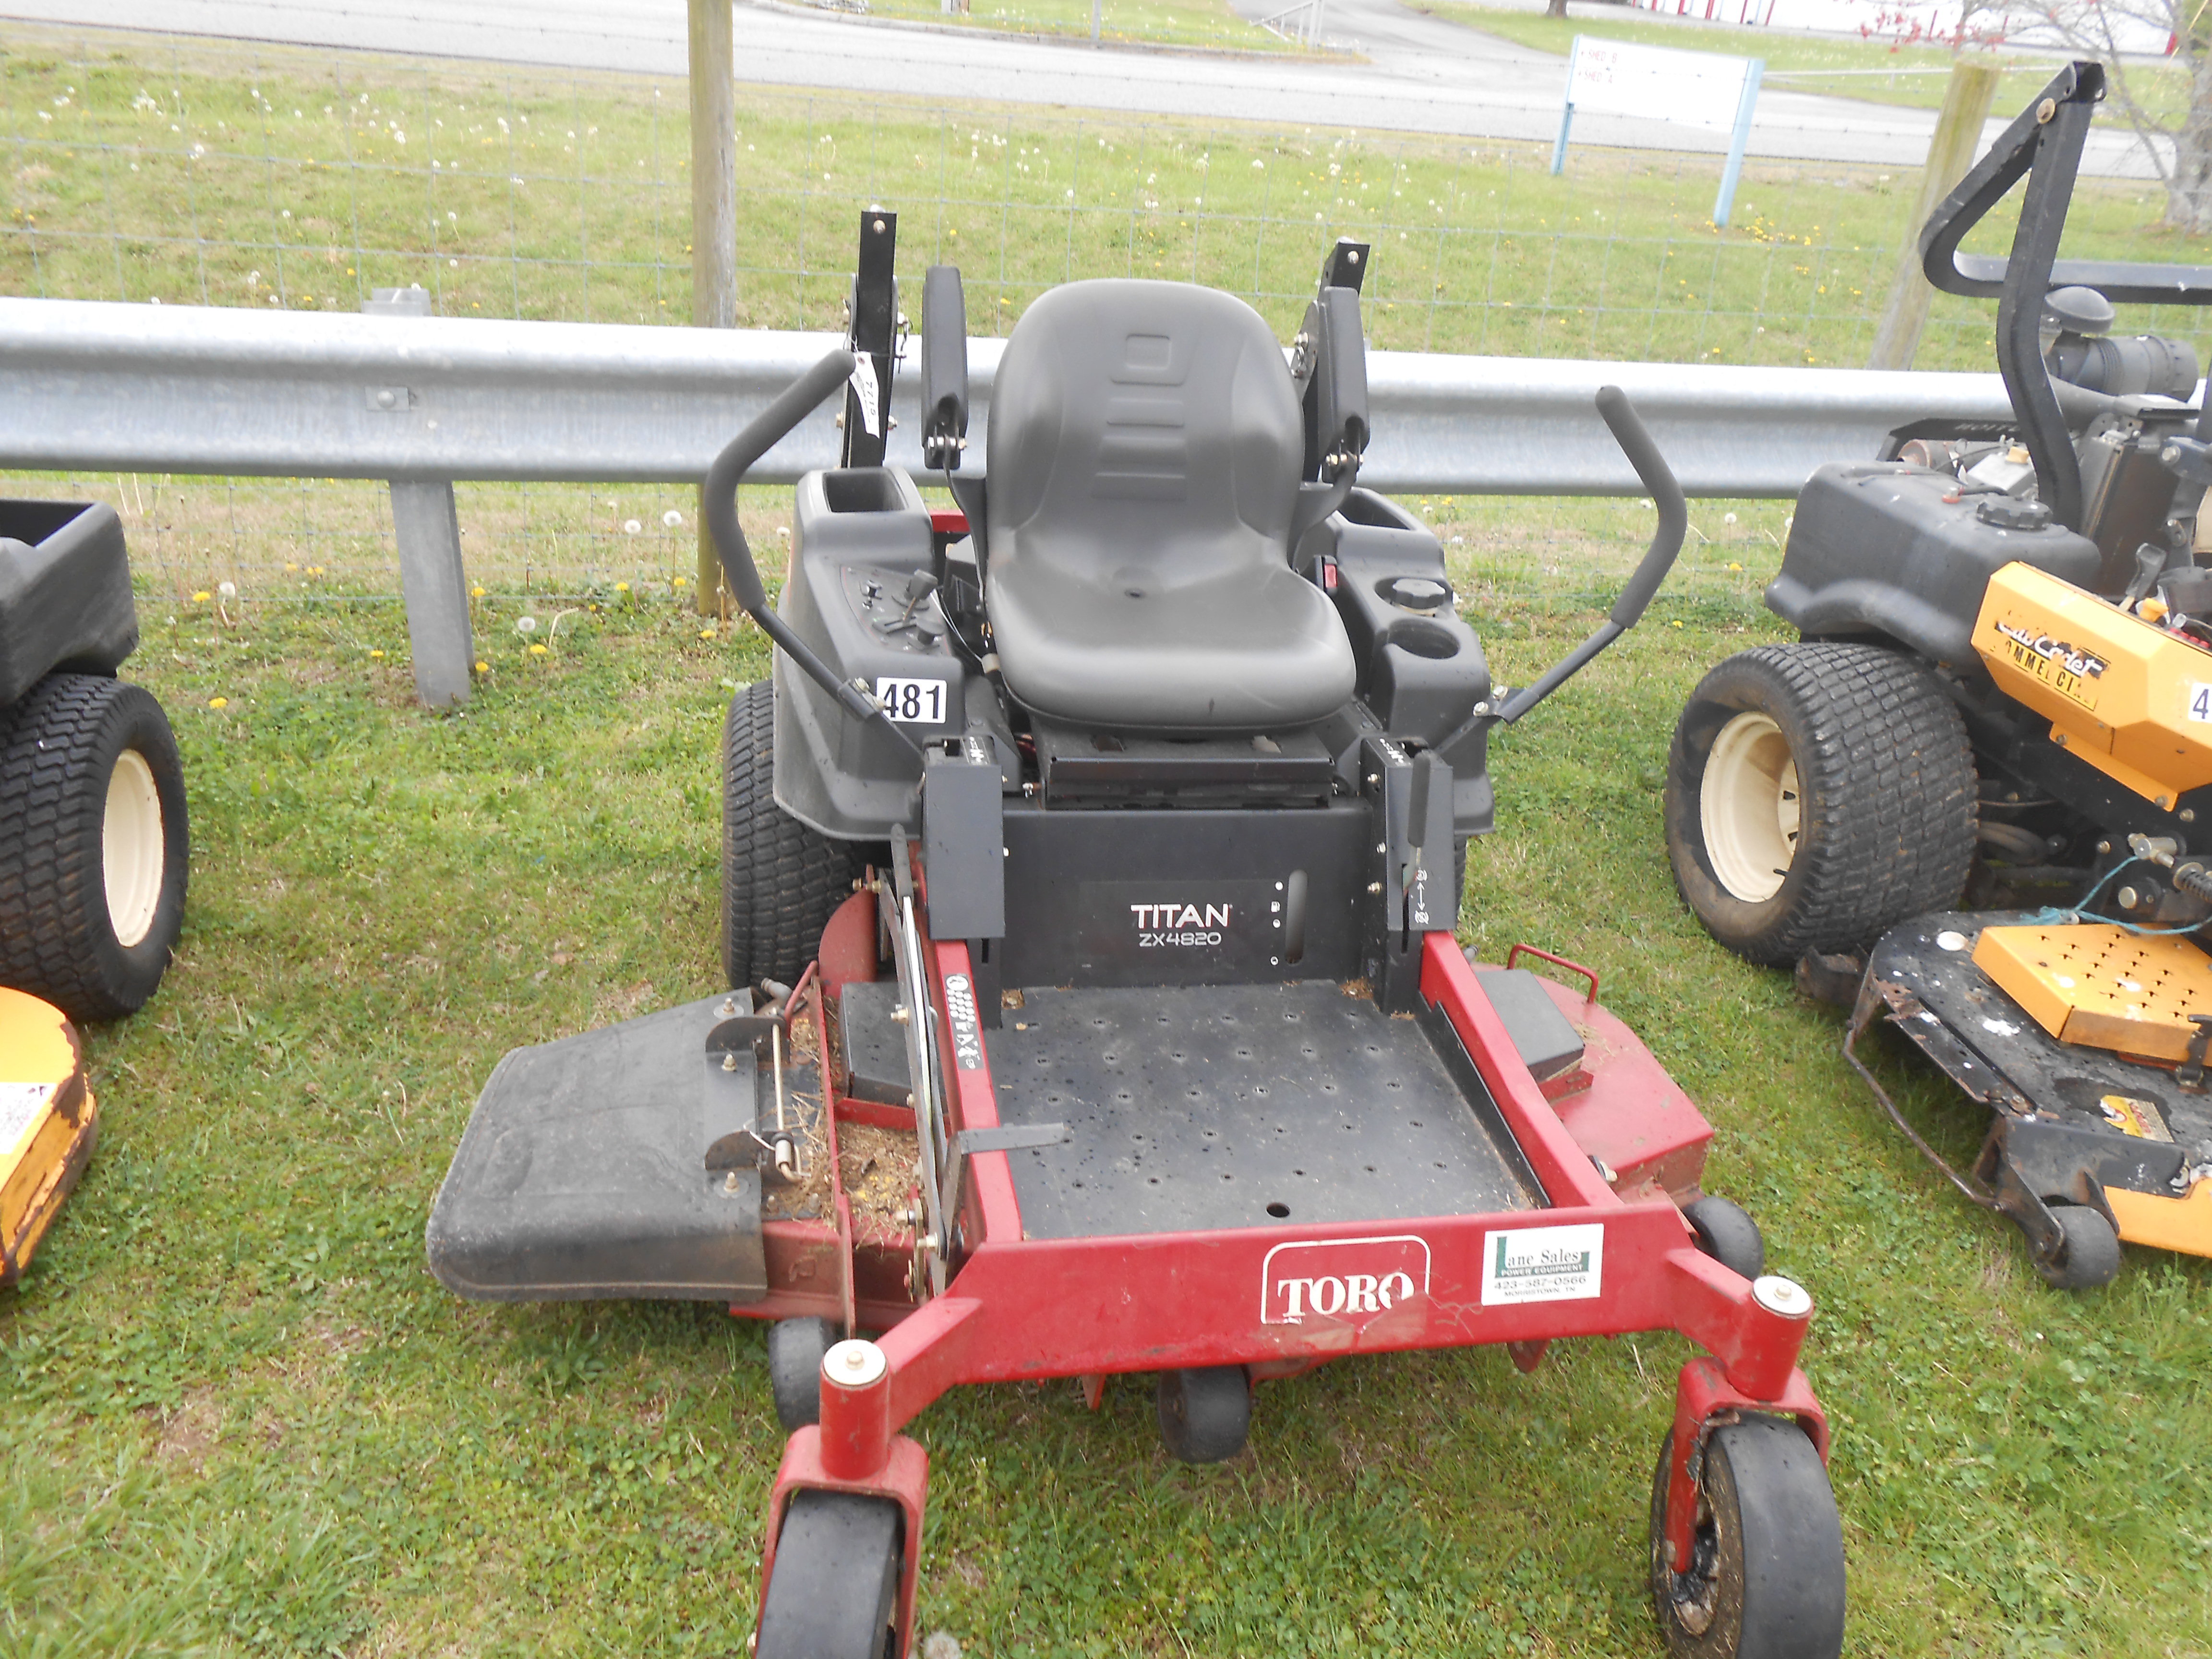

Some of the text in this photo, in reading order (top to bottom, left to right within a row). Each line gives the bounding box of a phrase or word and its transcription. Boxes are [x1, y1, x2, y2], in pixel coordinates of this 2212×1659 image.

[1588, 48, 1606, 61] SHED
[1584, 69, 1602, 82] SHED
[884, 684, 939, 719] 481
[1130, 903, 1230, 928] TITAN
[1139, 931, 1222, 947] ZX4820
[1496, 1236, 1579, 1270] Lane Sales
[1501, 1264, 1583, 1277] POWER EQUIPMENT
[1277, 1272, 1415, 1317] TORO
